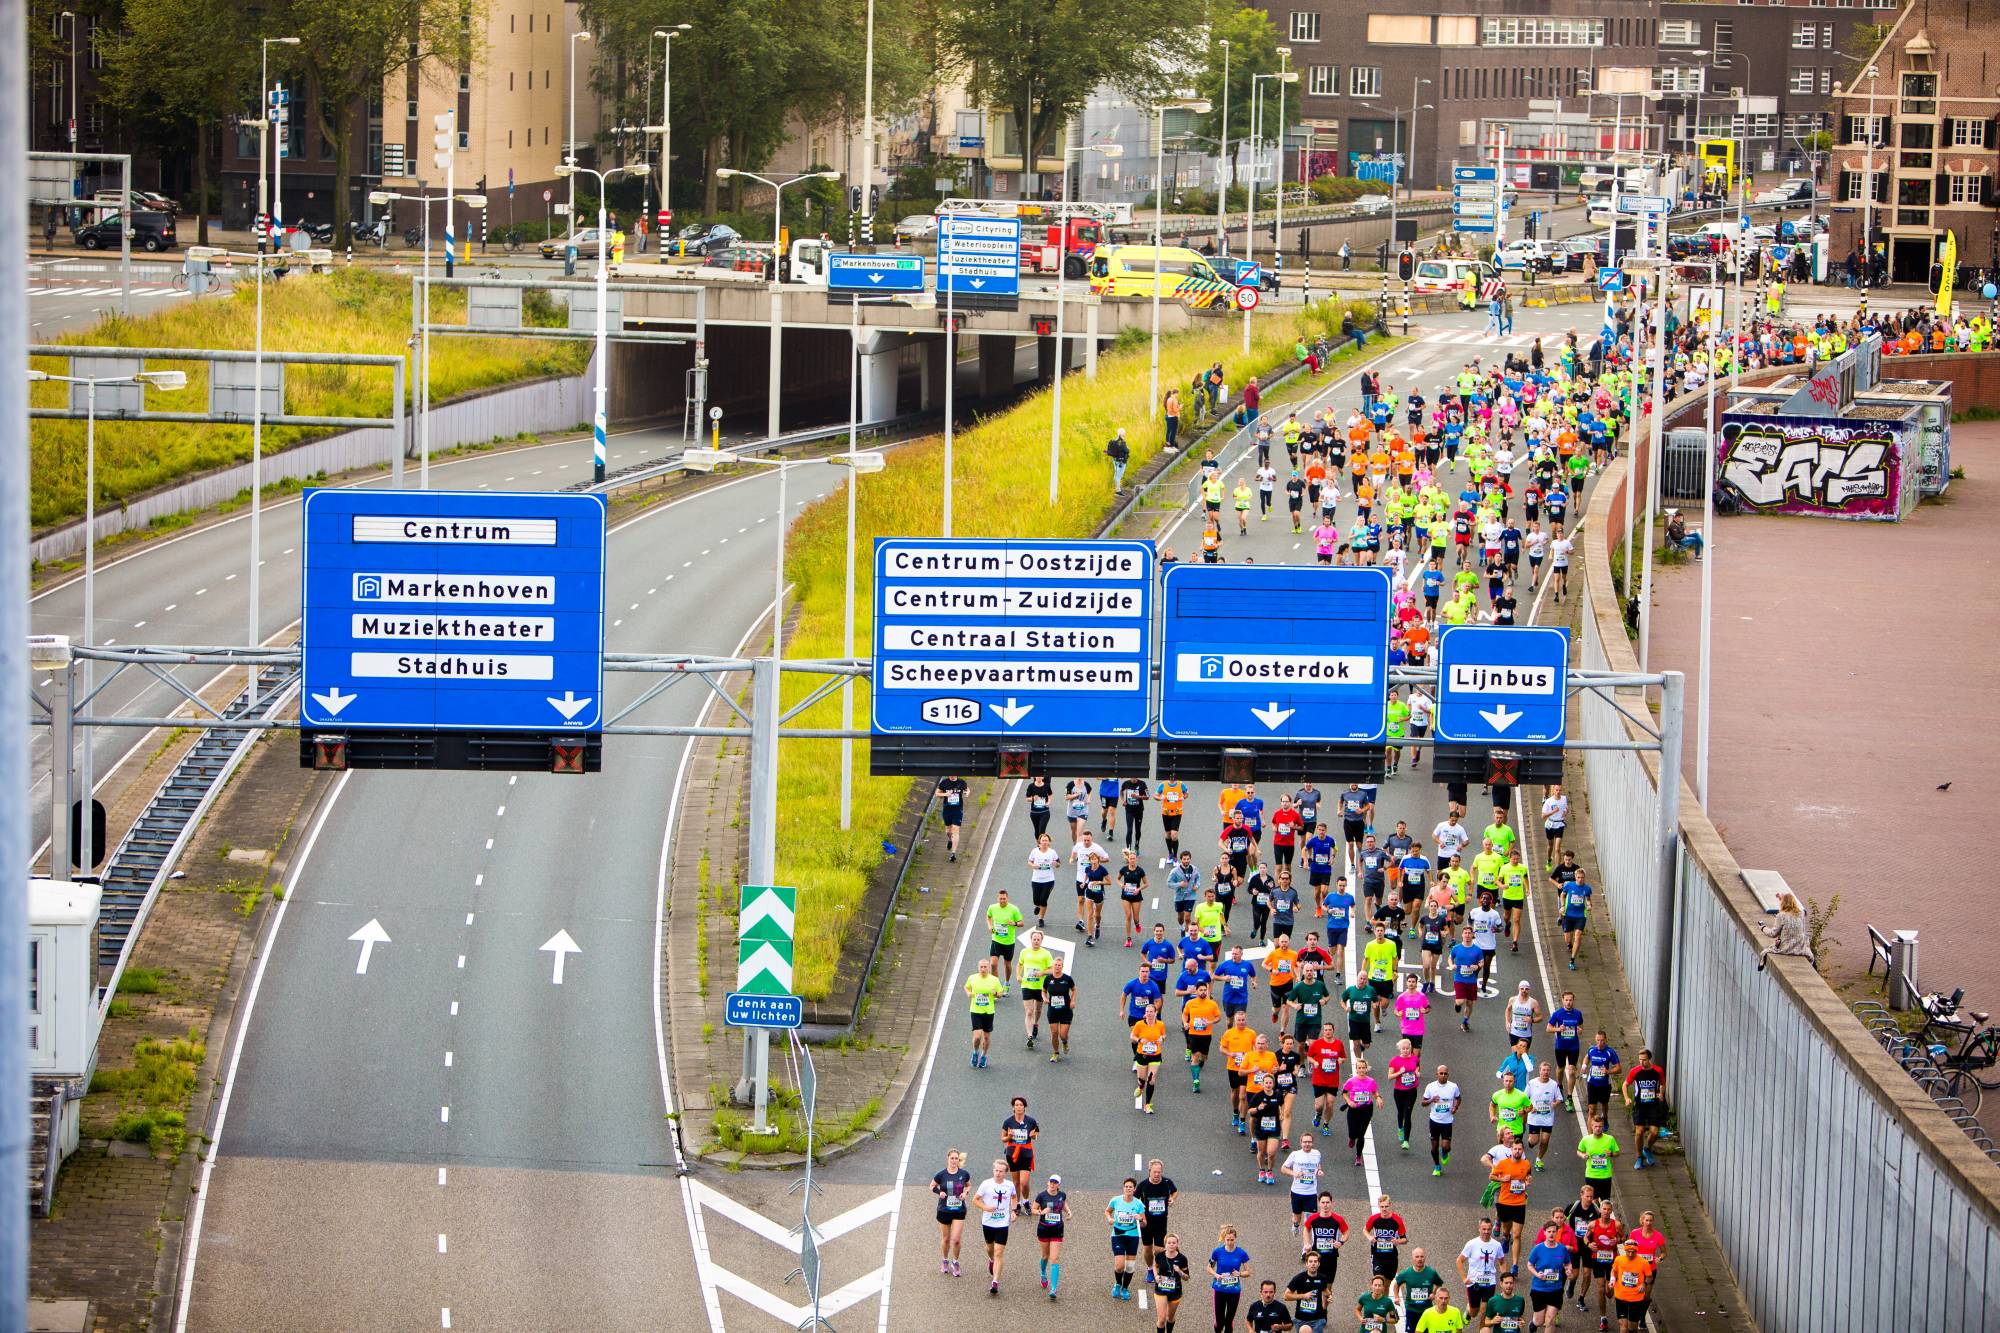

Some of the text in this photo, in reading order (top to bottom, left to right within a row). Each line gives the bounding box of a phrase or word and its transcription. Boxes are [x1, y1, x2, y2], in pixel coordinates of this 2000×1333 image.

[976, 225, 1012, 235] Cityring
[954, 240, 1013, 249] Waterlooplein
[842, 260, 896, 268] Markenhoven
[959, 267, 997, 275] Stadhuis
[1240, 293, 1253, 302] 50
[403, 521, 511, 540] Centrum
[387, 579, 549, 599] Markenhoven
[362, 618, 544, 638] Muziektheater
[910, 629, 1115, 649] Centraal Station
[397, 657, 509, 676] Stadhuis
[890, 665, 1134, 685] Scheepvaartmuseum
[1229, 660, 1350, 679] Oosterdok
[1456, 668, 1548, 691] Lijnbus
[737, 998, 792, 1010] denk aan
[732, 1010, 796, 1021] uw lichten
